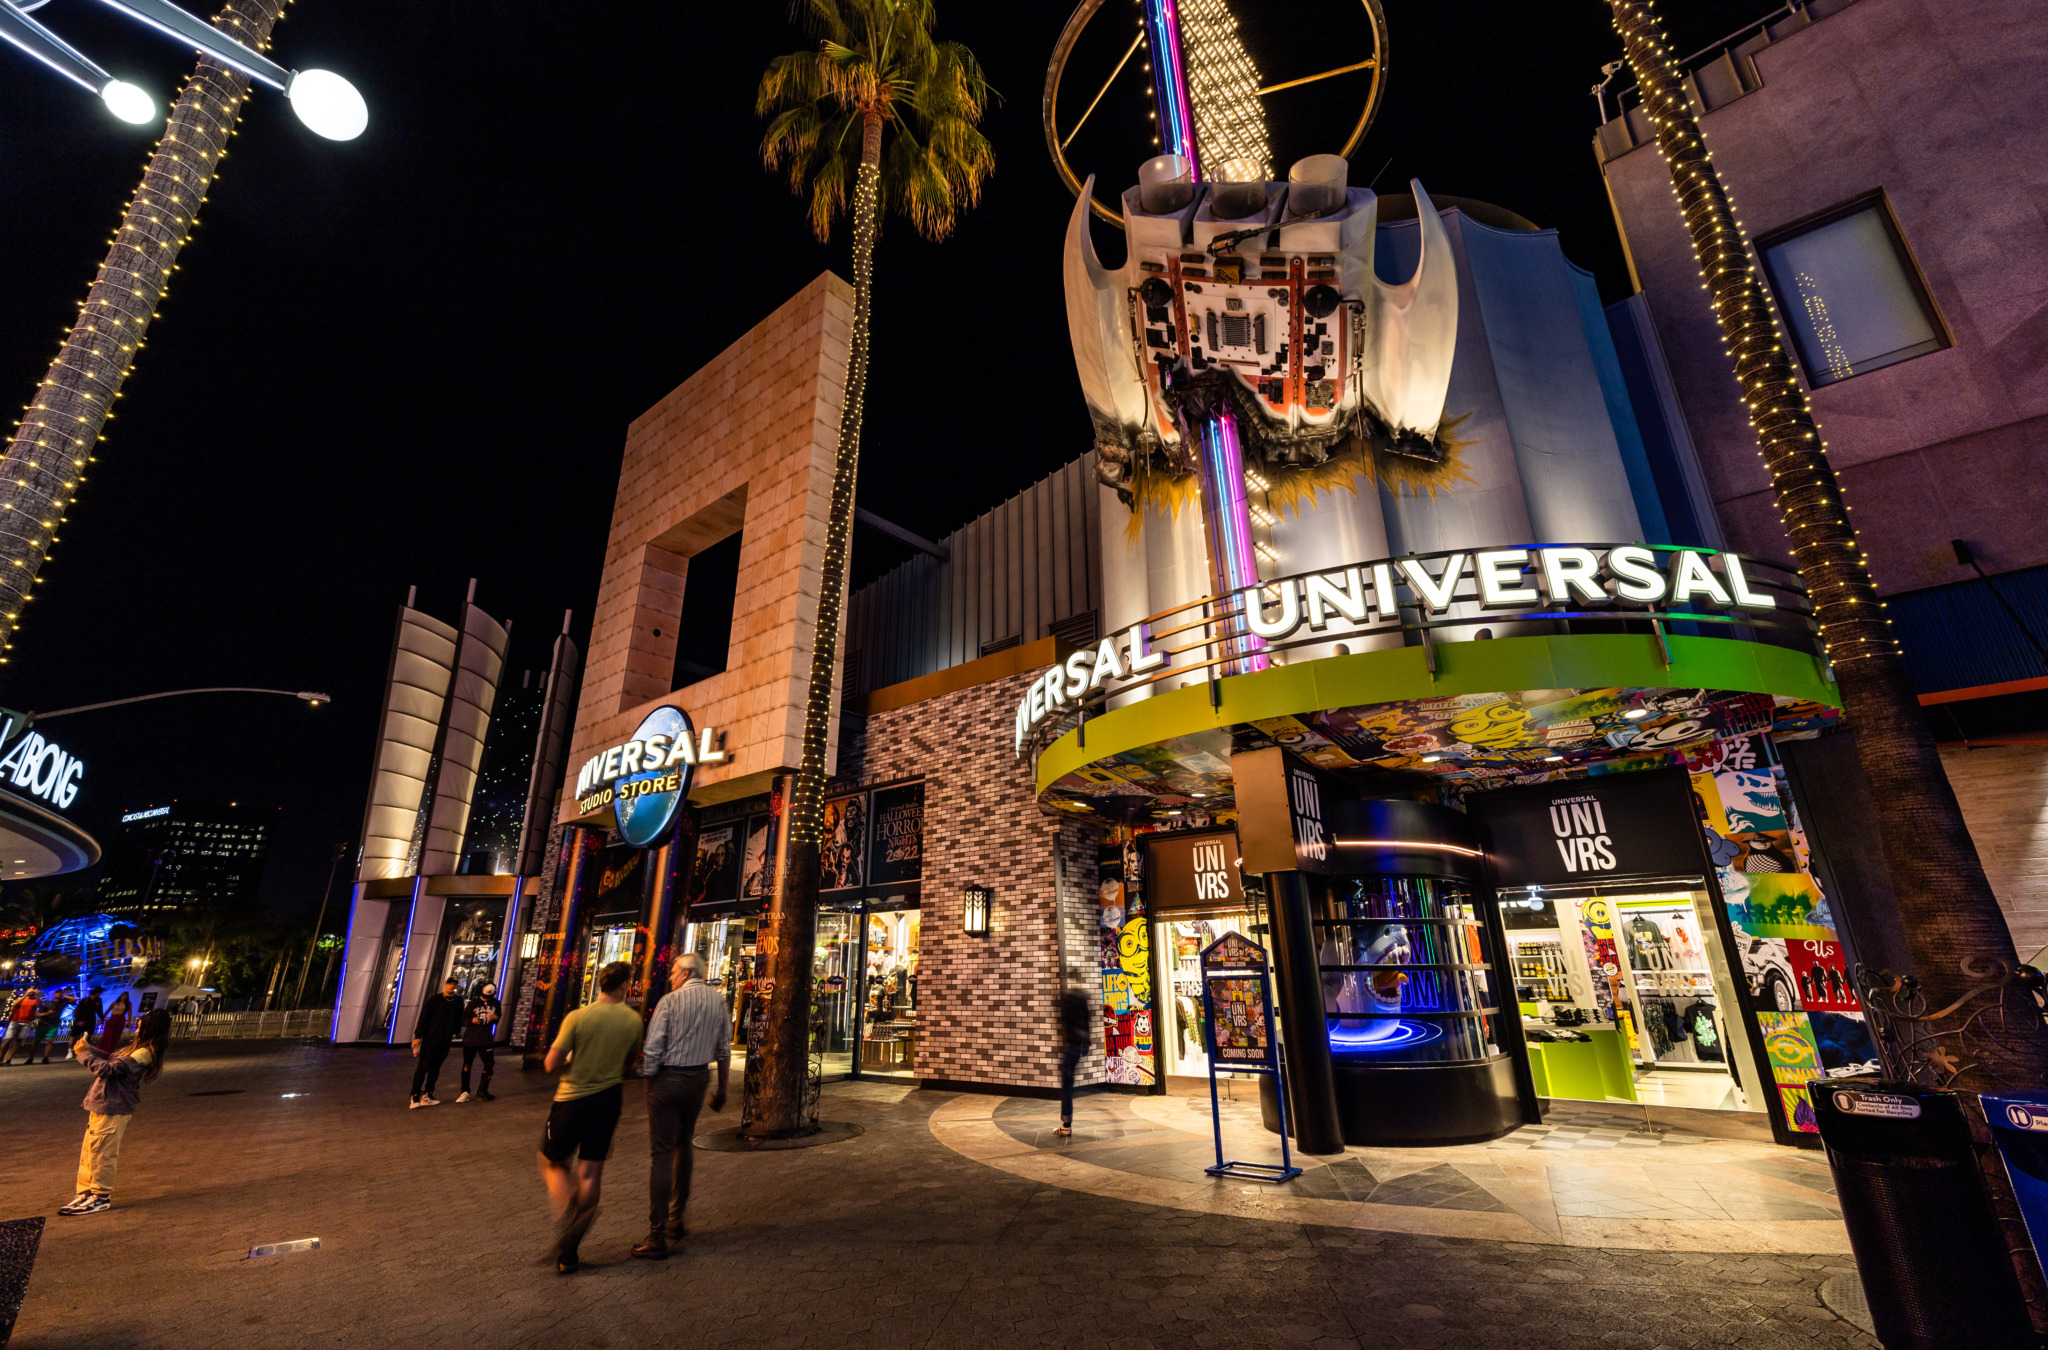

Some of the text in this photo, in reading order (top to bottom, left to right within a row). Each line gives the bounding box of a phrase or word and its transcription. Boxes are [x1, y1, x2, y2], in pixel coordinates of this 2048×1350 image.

[1244, 546, 1777, 642] UNIVERSAL
[1293, 768, 1317, 782] UNIVERSAL
[579, 775, 680, 815] STUDIO STORE
[1292, 775, 1321, 820] UNI
[1551, 794, 1598, 806] UNIVERSAL
[1549, 801, 1608, 838] UNI
[887, 834, 917, 849] NIGHTS
[1194, 839, 1222, 847] UNIVERSAL
[1296, 815, 1327, 862] VRS
[1192, 844, 1226, 873] UNI
[1556, 835, 1617, 873] VRS
[1194, 871, 1230, 900] VRS
[1227, 939, 1238, 948] UNI
[1803, 940, 1835, 958] Us
[1228, 947, 1239, 957] VRS
[1231, 1003, 1246, 1015] UNI
[1232, 1015, 1248, 1027] VRS
[1222, 1048, 1264, 1059] COMING SOON
[1860, 1094, 1902, 1105] Trash Only
